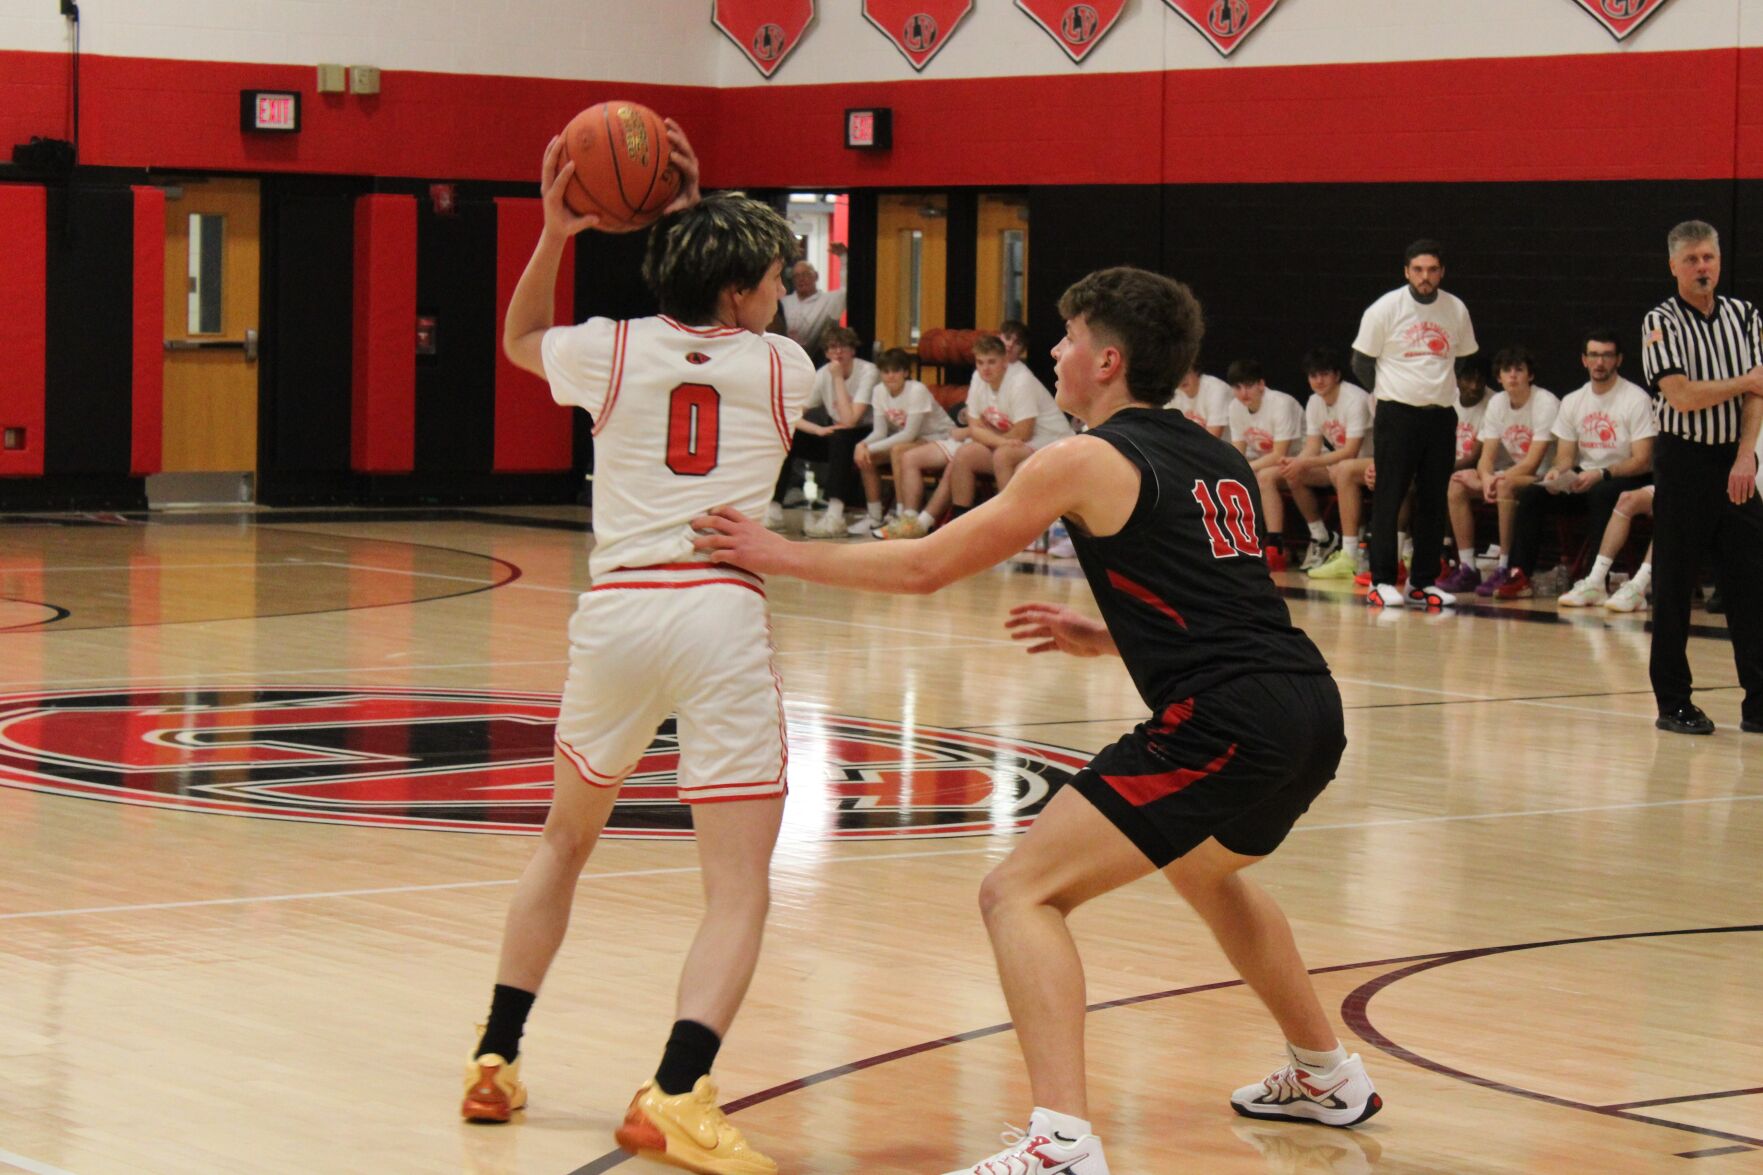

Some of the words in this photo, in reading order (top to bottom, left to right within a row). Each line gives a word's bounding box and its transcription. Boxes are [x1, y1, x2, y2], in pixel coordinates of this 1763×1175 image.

[259, 97, 291, 123] EXIT
[665, 382, 721, 476] 0
[1191, 479, 1262, 558] 10
